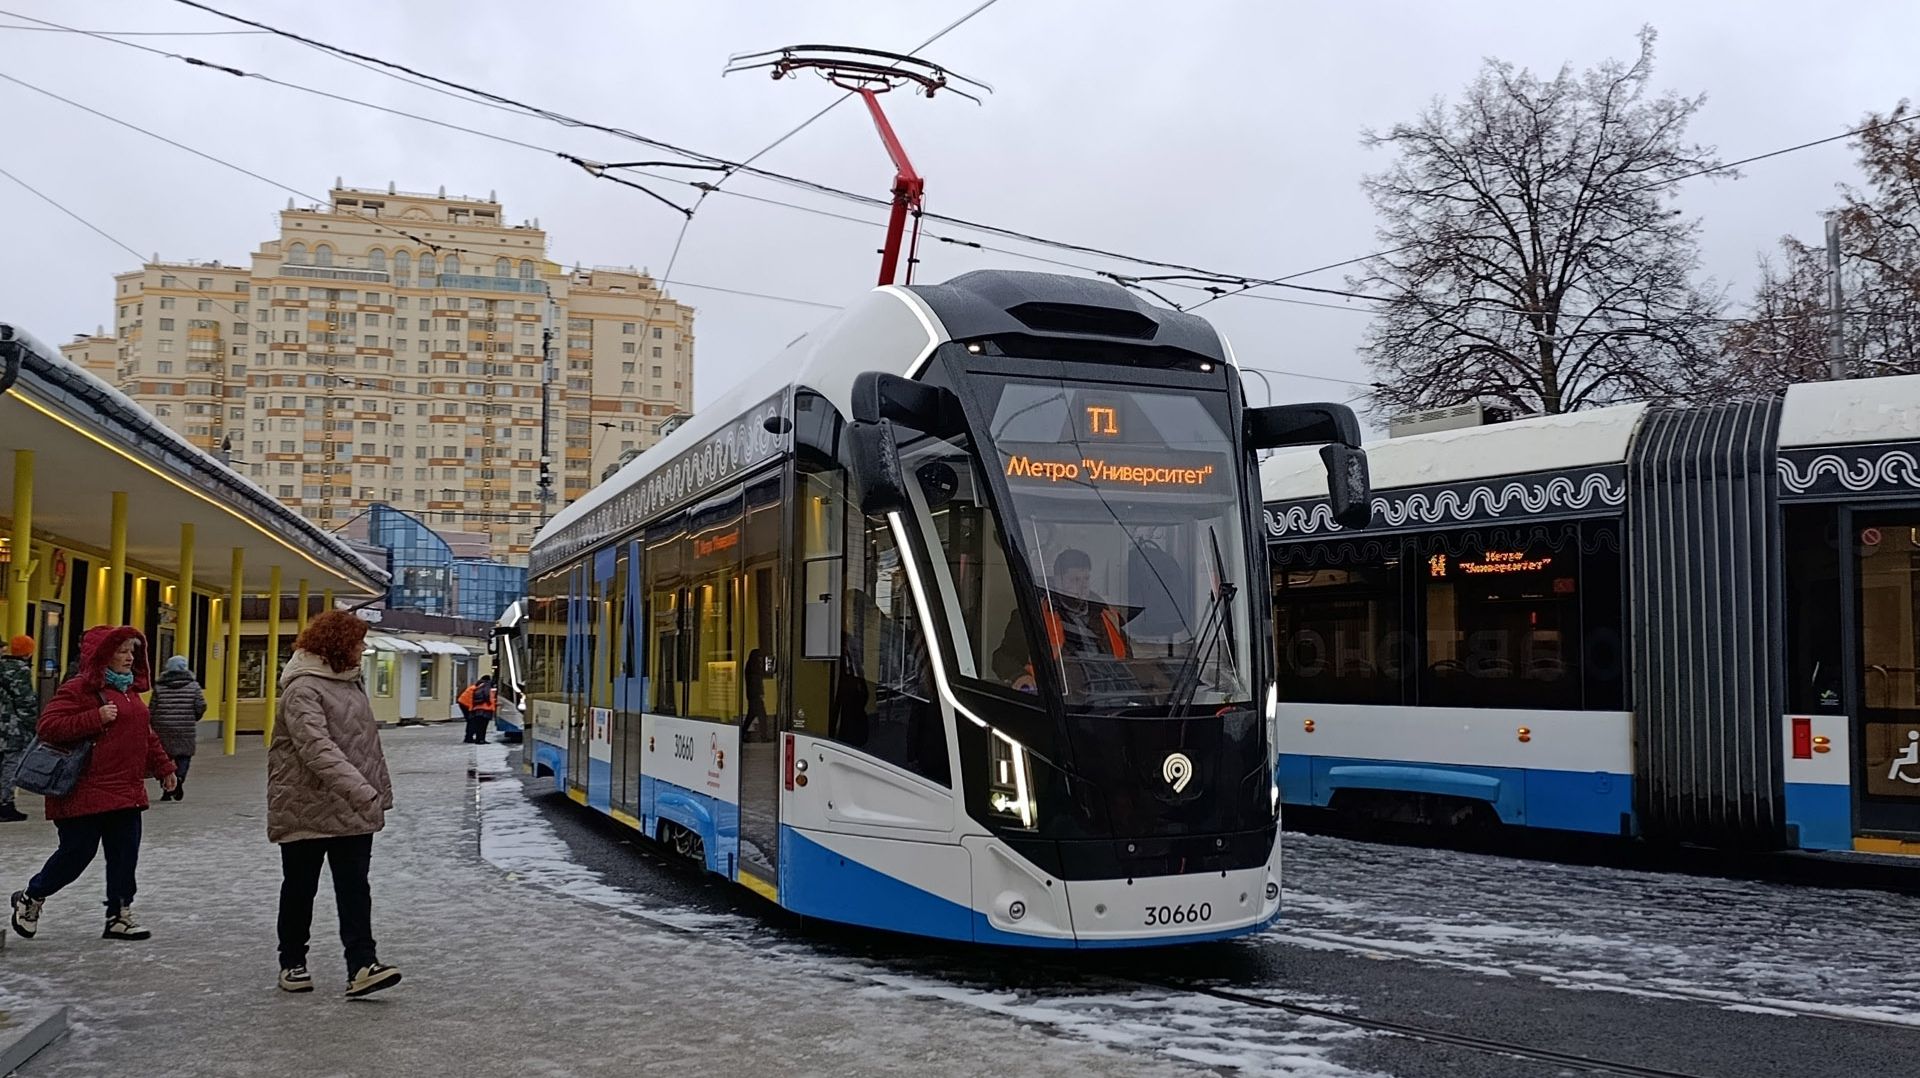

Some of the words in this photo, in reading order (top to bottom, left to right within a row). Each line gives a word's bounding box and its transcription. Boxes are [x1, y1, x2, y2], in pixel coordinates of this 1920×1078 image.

[1086, 406, 1118, 435] Т1
[1007, 456, 1078, 482] Метро
[1082, 459, 1213, 486] "Университет"
[674, 733, 694, 762] 30660
[1144, 902, 1212, 926] 30660
